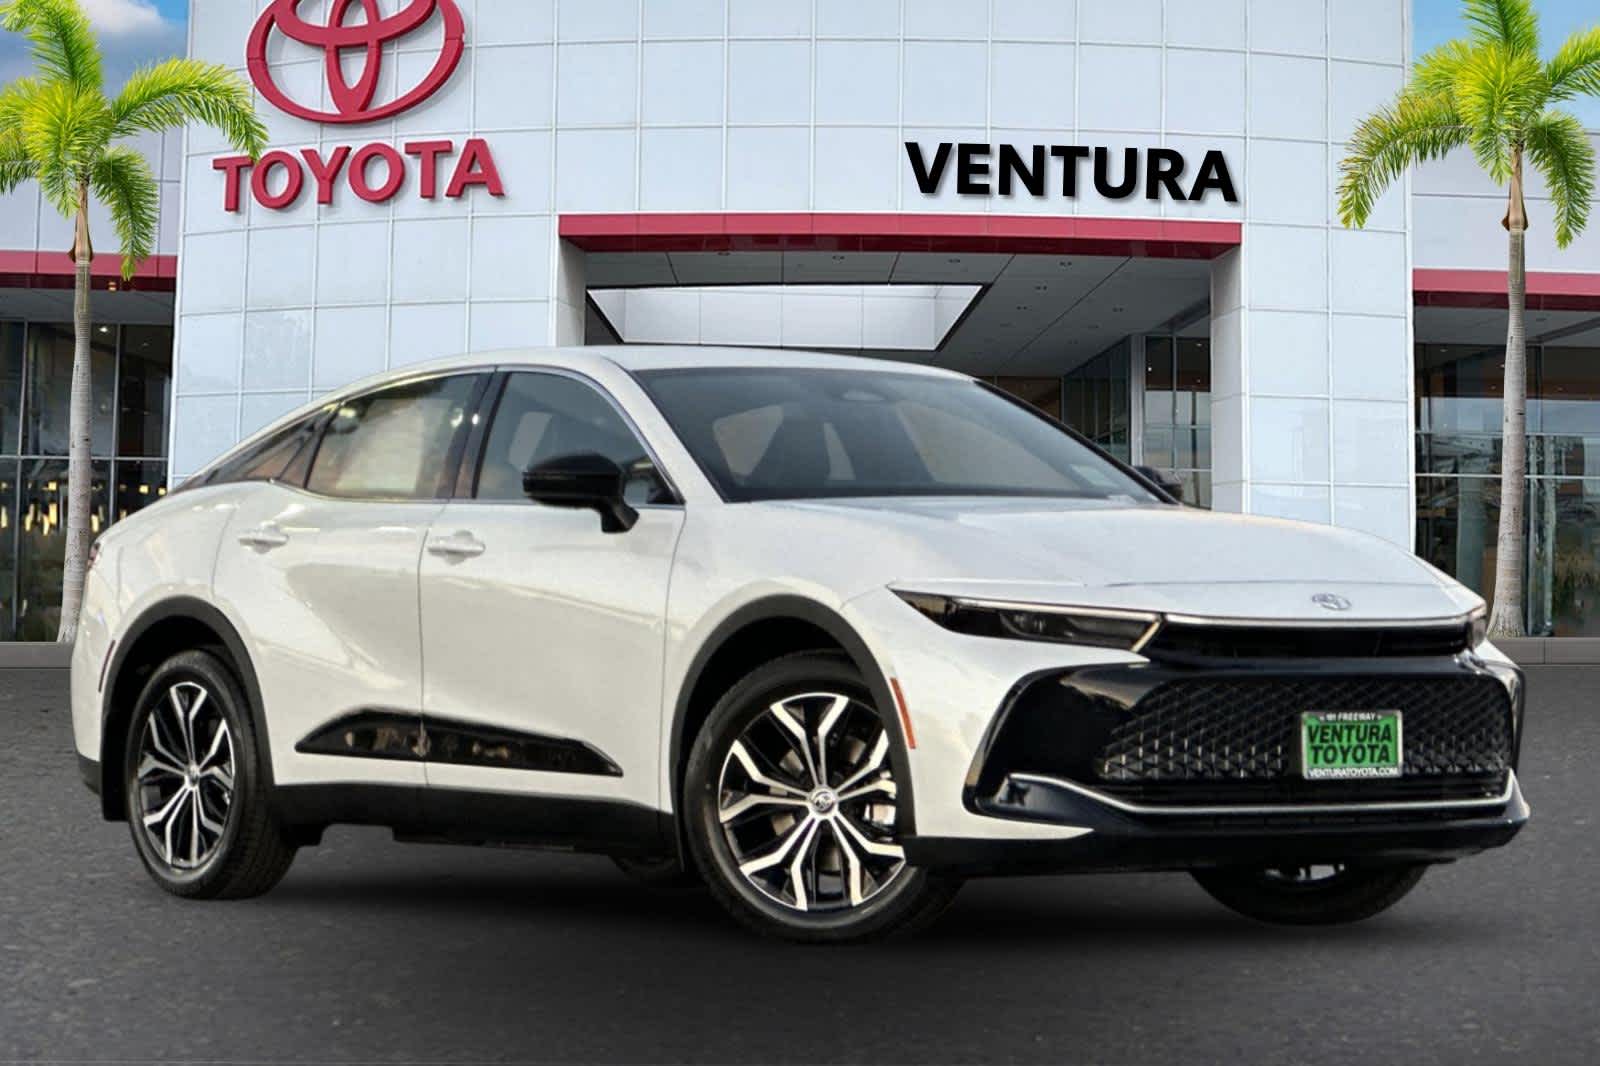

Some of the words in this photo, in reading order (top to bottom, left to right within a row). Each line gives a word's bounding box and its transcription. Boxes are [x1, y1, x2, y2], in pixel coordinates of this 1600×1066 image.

[212, 138, 505, 213] TOYOTA
[905, 142, 1238, 203] VENTURA
[1307, 724, 1392, 743] VENTURA
[1311, 744, 1390, 764] TOYOTA
